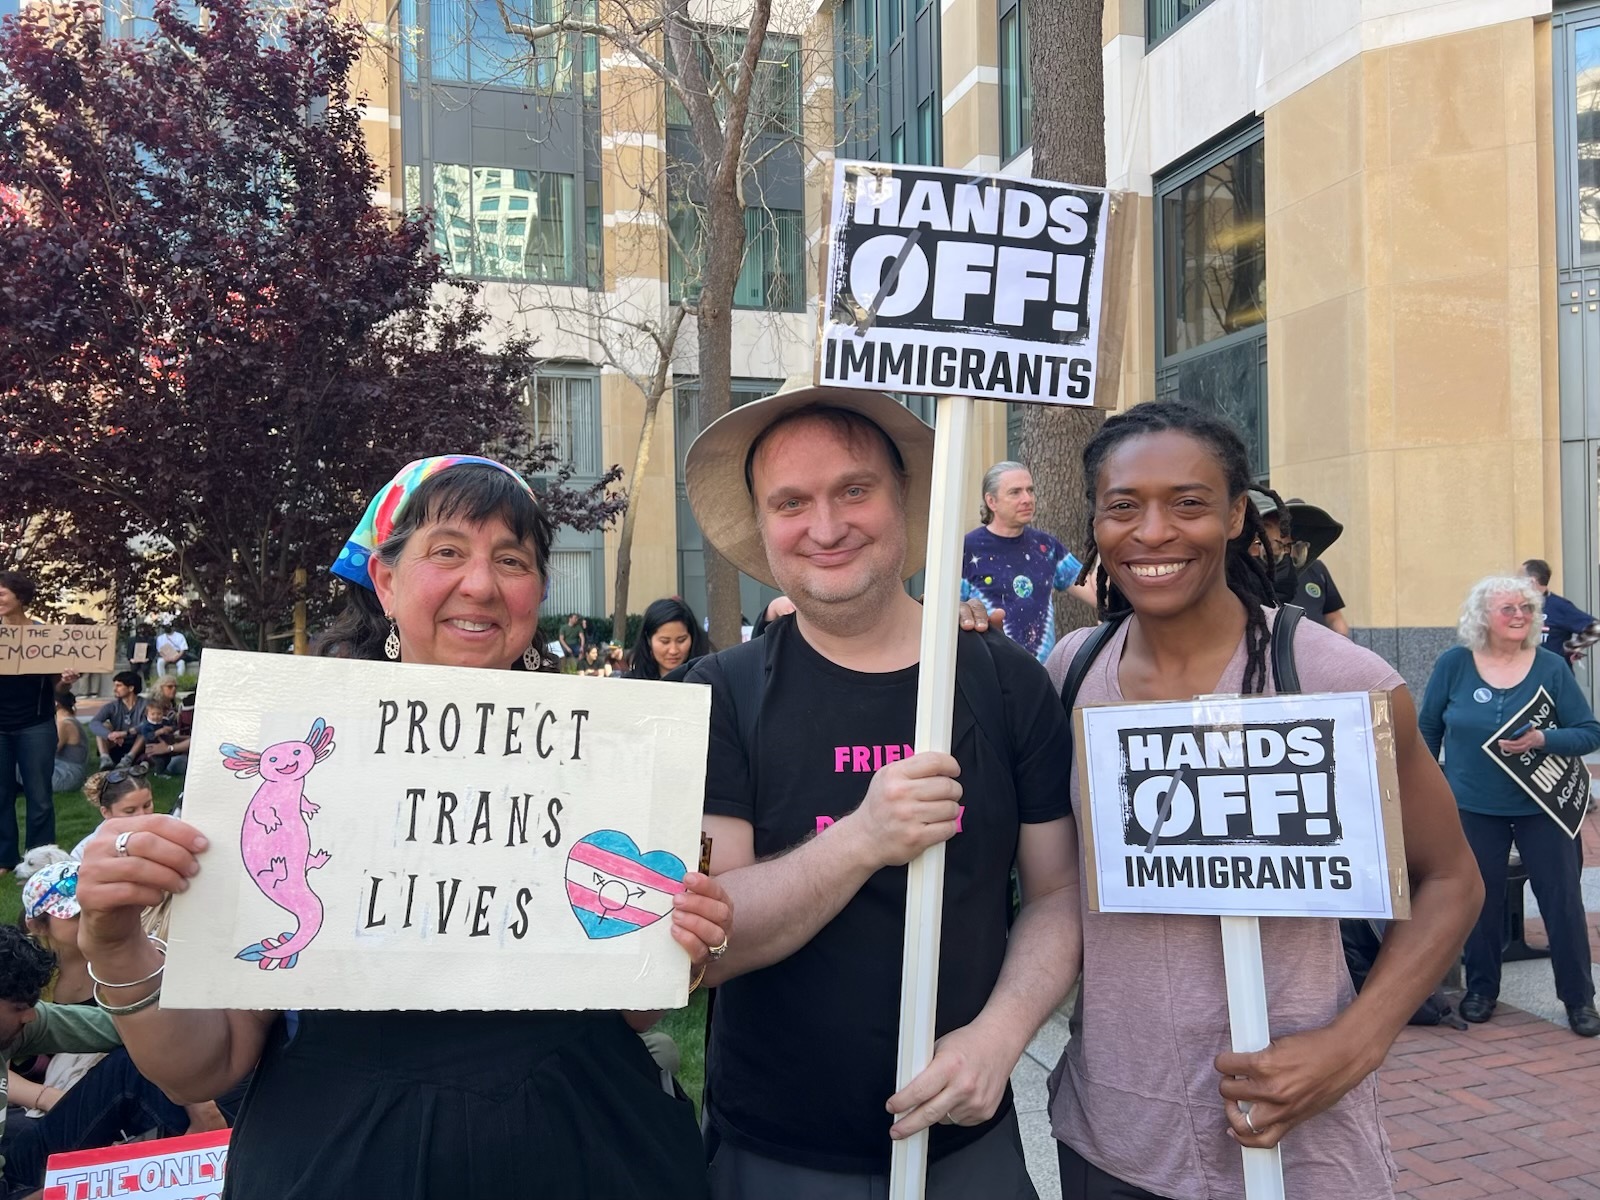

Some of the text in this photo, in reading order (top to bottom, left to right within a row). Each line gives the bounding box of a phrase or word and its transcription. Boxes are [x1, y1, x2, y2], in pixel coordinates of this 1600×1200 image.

[854, 176, 1089, 245] HANDS
[824, 338, 1092, 399] IMMIGRANTS
[27, 629, 51, 638] THE
[59, 629, 108, 641] SOUL
[374, 699, 589, 760] PROTECT
[1127, 726, 1325, 771] HANDS
[405, 788, 563, 848] TRANS
[1133, 772, 1331, 837] OFF!
[1125, 856, 1353, 890] IMMIGRANTS
[365, 875, 533, 940] LIVES
[57, 1150, 228, 1200] THE ONLY
